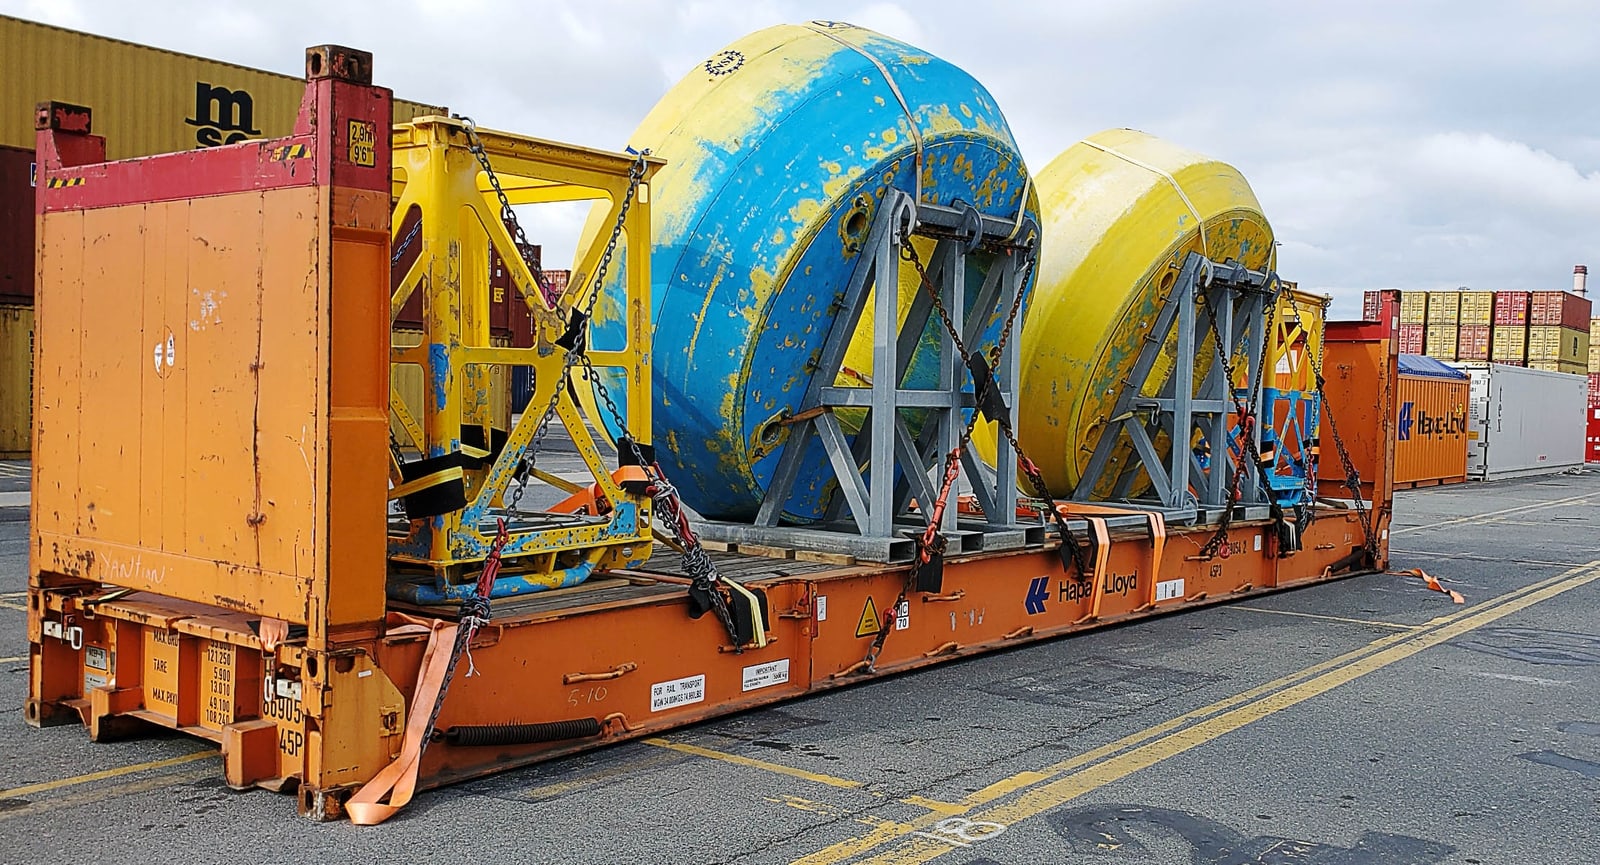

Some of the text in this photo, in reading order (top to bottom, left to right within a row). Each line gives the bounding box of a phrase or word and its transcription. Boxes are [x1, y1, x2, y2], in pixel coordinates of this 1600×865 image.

[1059, 570, 1138, 604] Hapa-Lloyd
[898, 617, 907, 628] 70
[153, 658, 168, 673] TARE
[207, 649, 231, 666] 121.250
[214, 667, 231, 682] 5.900
[211, 680, 230, 696] 13.010
[653, 678, 702, 696] FOR RAIL TRANSPORT
[209, 696, 230, 713] 49.100
[280, 728, 303, 757] 45P
